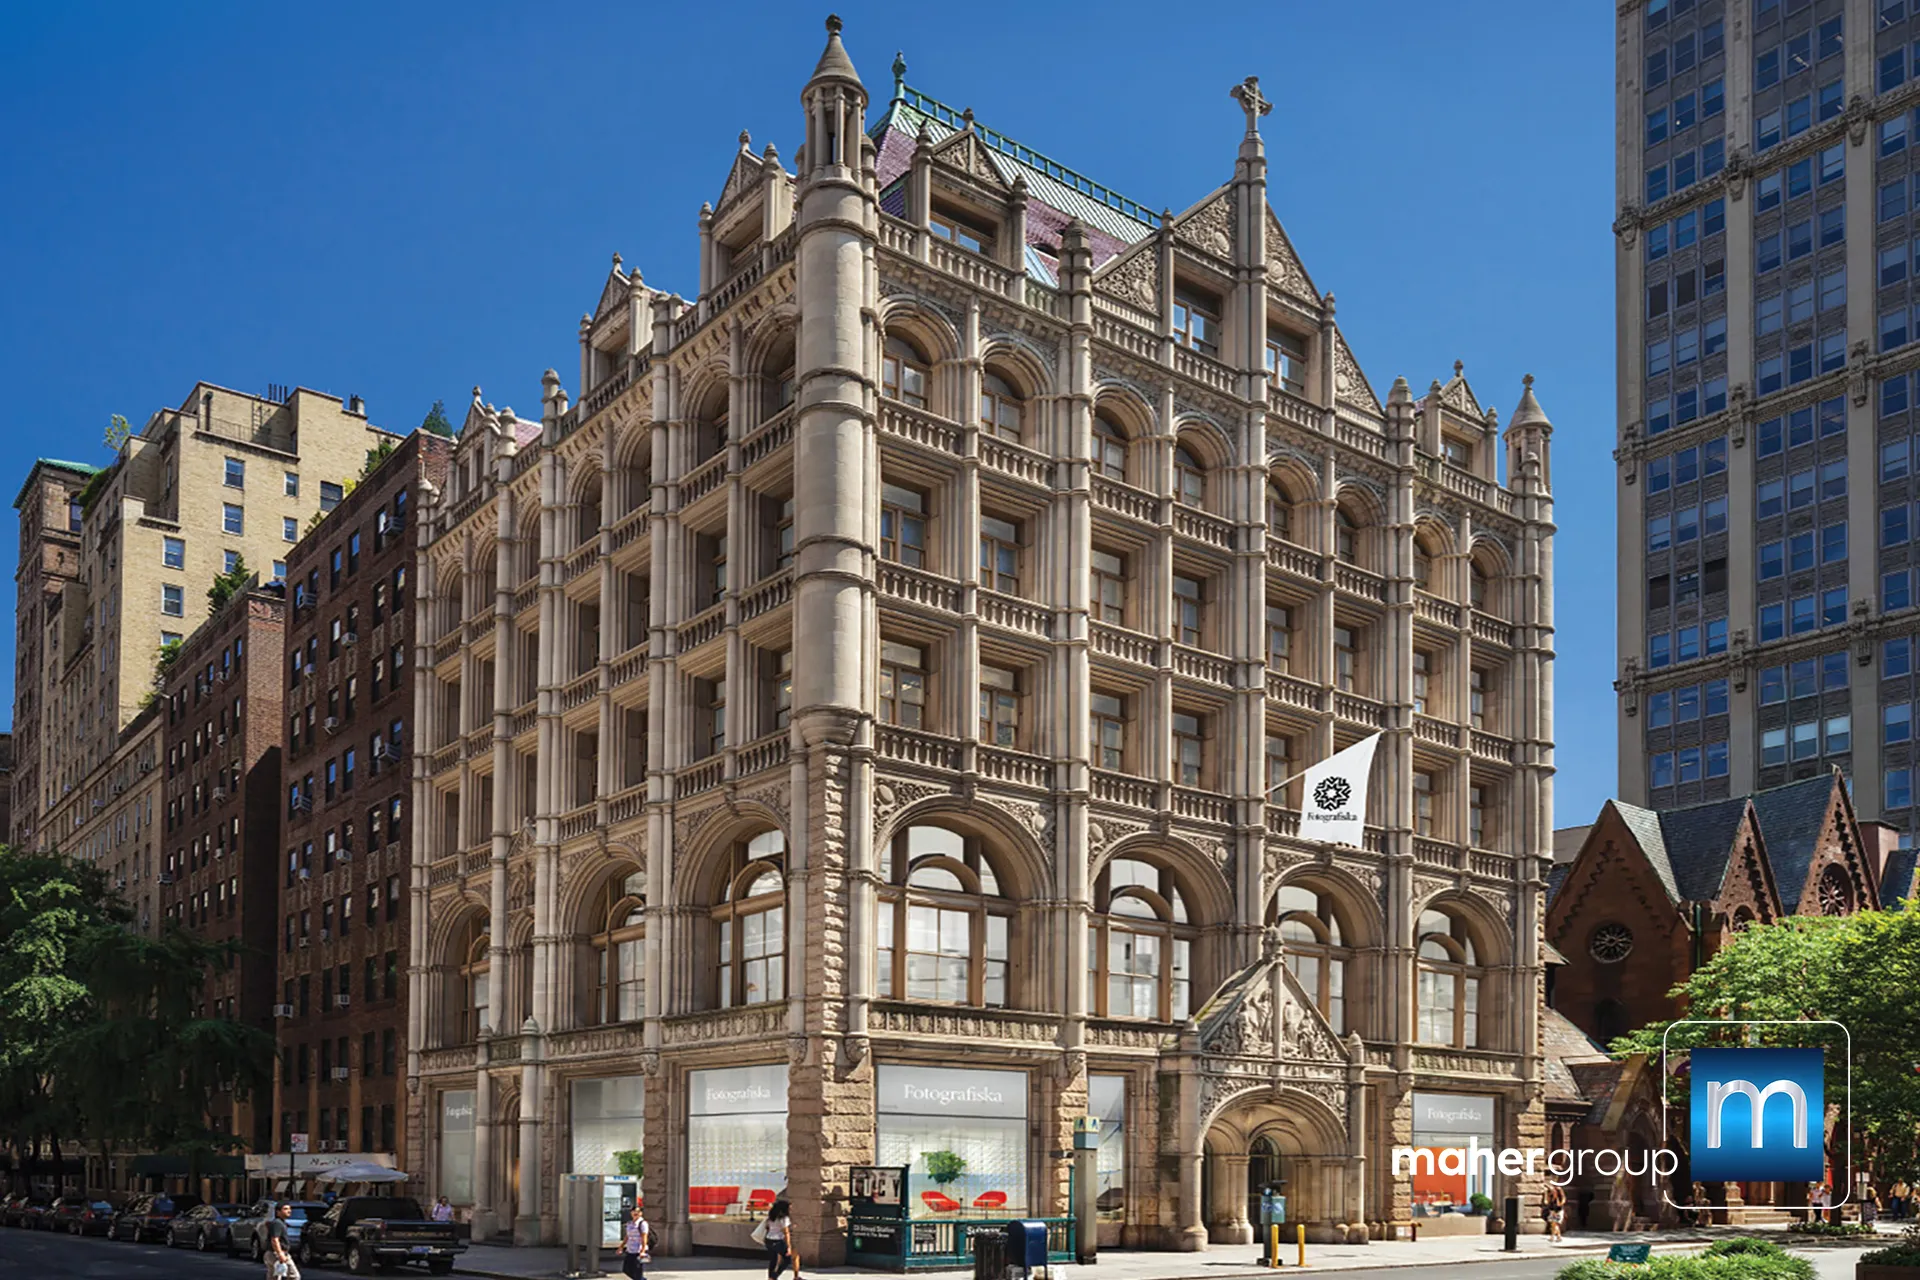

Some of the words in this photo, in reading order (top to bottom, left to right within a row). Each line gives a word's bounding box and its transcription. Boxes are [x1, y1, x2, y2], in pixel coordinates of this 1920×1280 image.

[1307, 811, 1358, 823] Fotografiska
[706, 1085, 771, 1103] Fotografiska
[904, 1083, 1003, 1105] Fotografiska
[1427, 1107, 1482, 1124] Fotografiska
